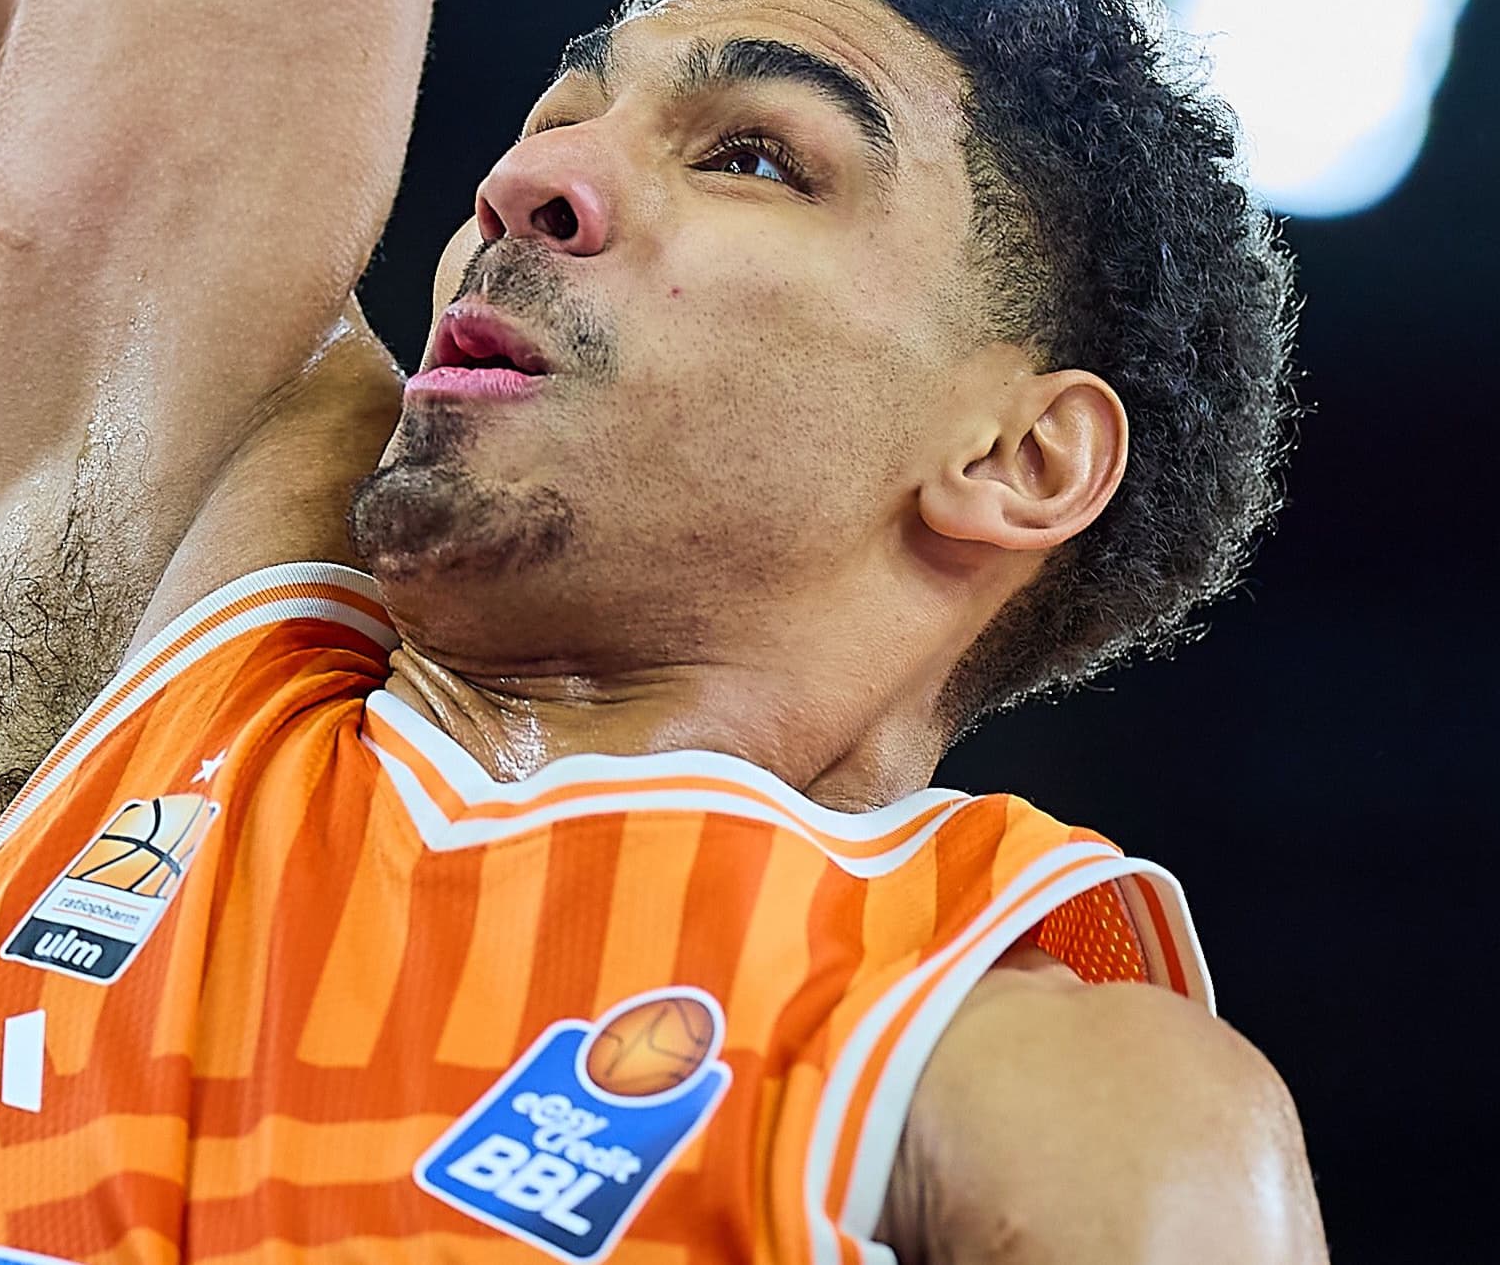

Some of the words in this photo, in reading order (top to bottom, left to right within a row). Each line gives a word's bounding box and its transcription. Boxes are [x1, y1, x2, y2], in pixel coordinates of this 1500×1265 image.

[58, 895, 141, 925] ratiopharm
[33, 928, 103, 969] ulm
[445, 1133, 603, 1236] BBL
